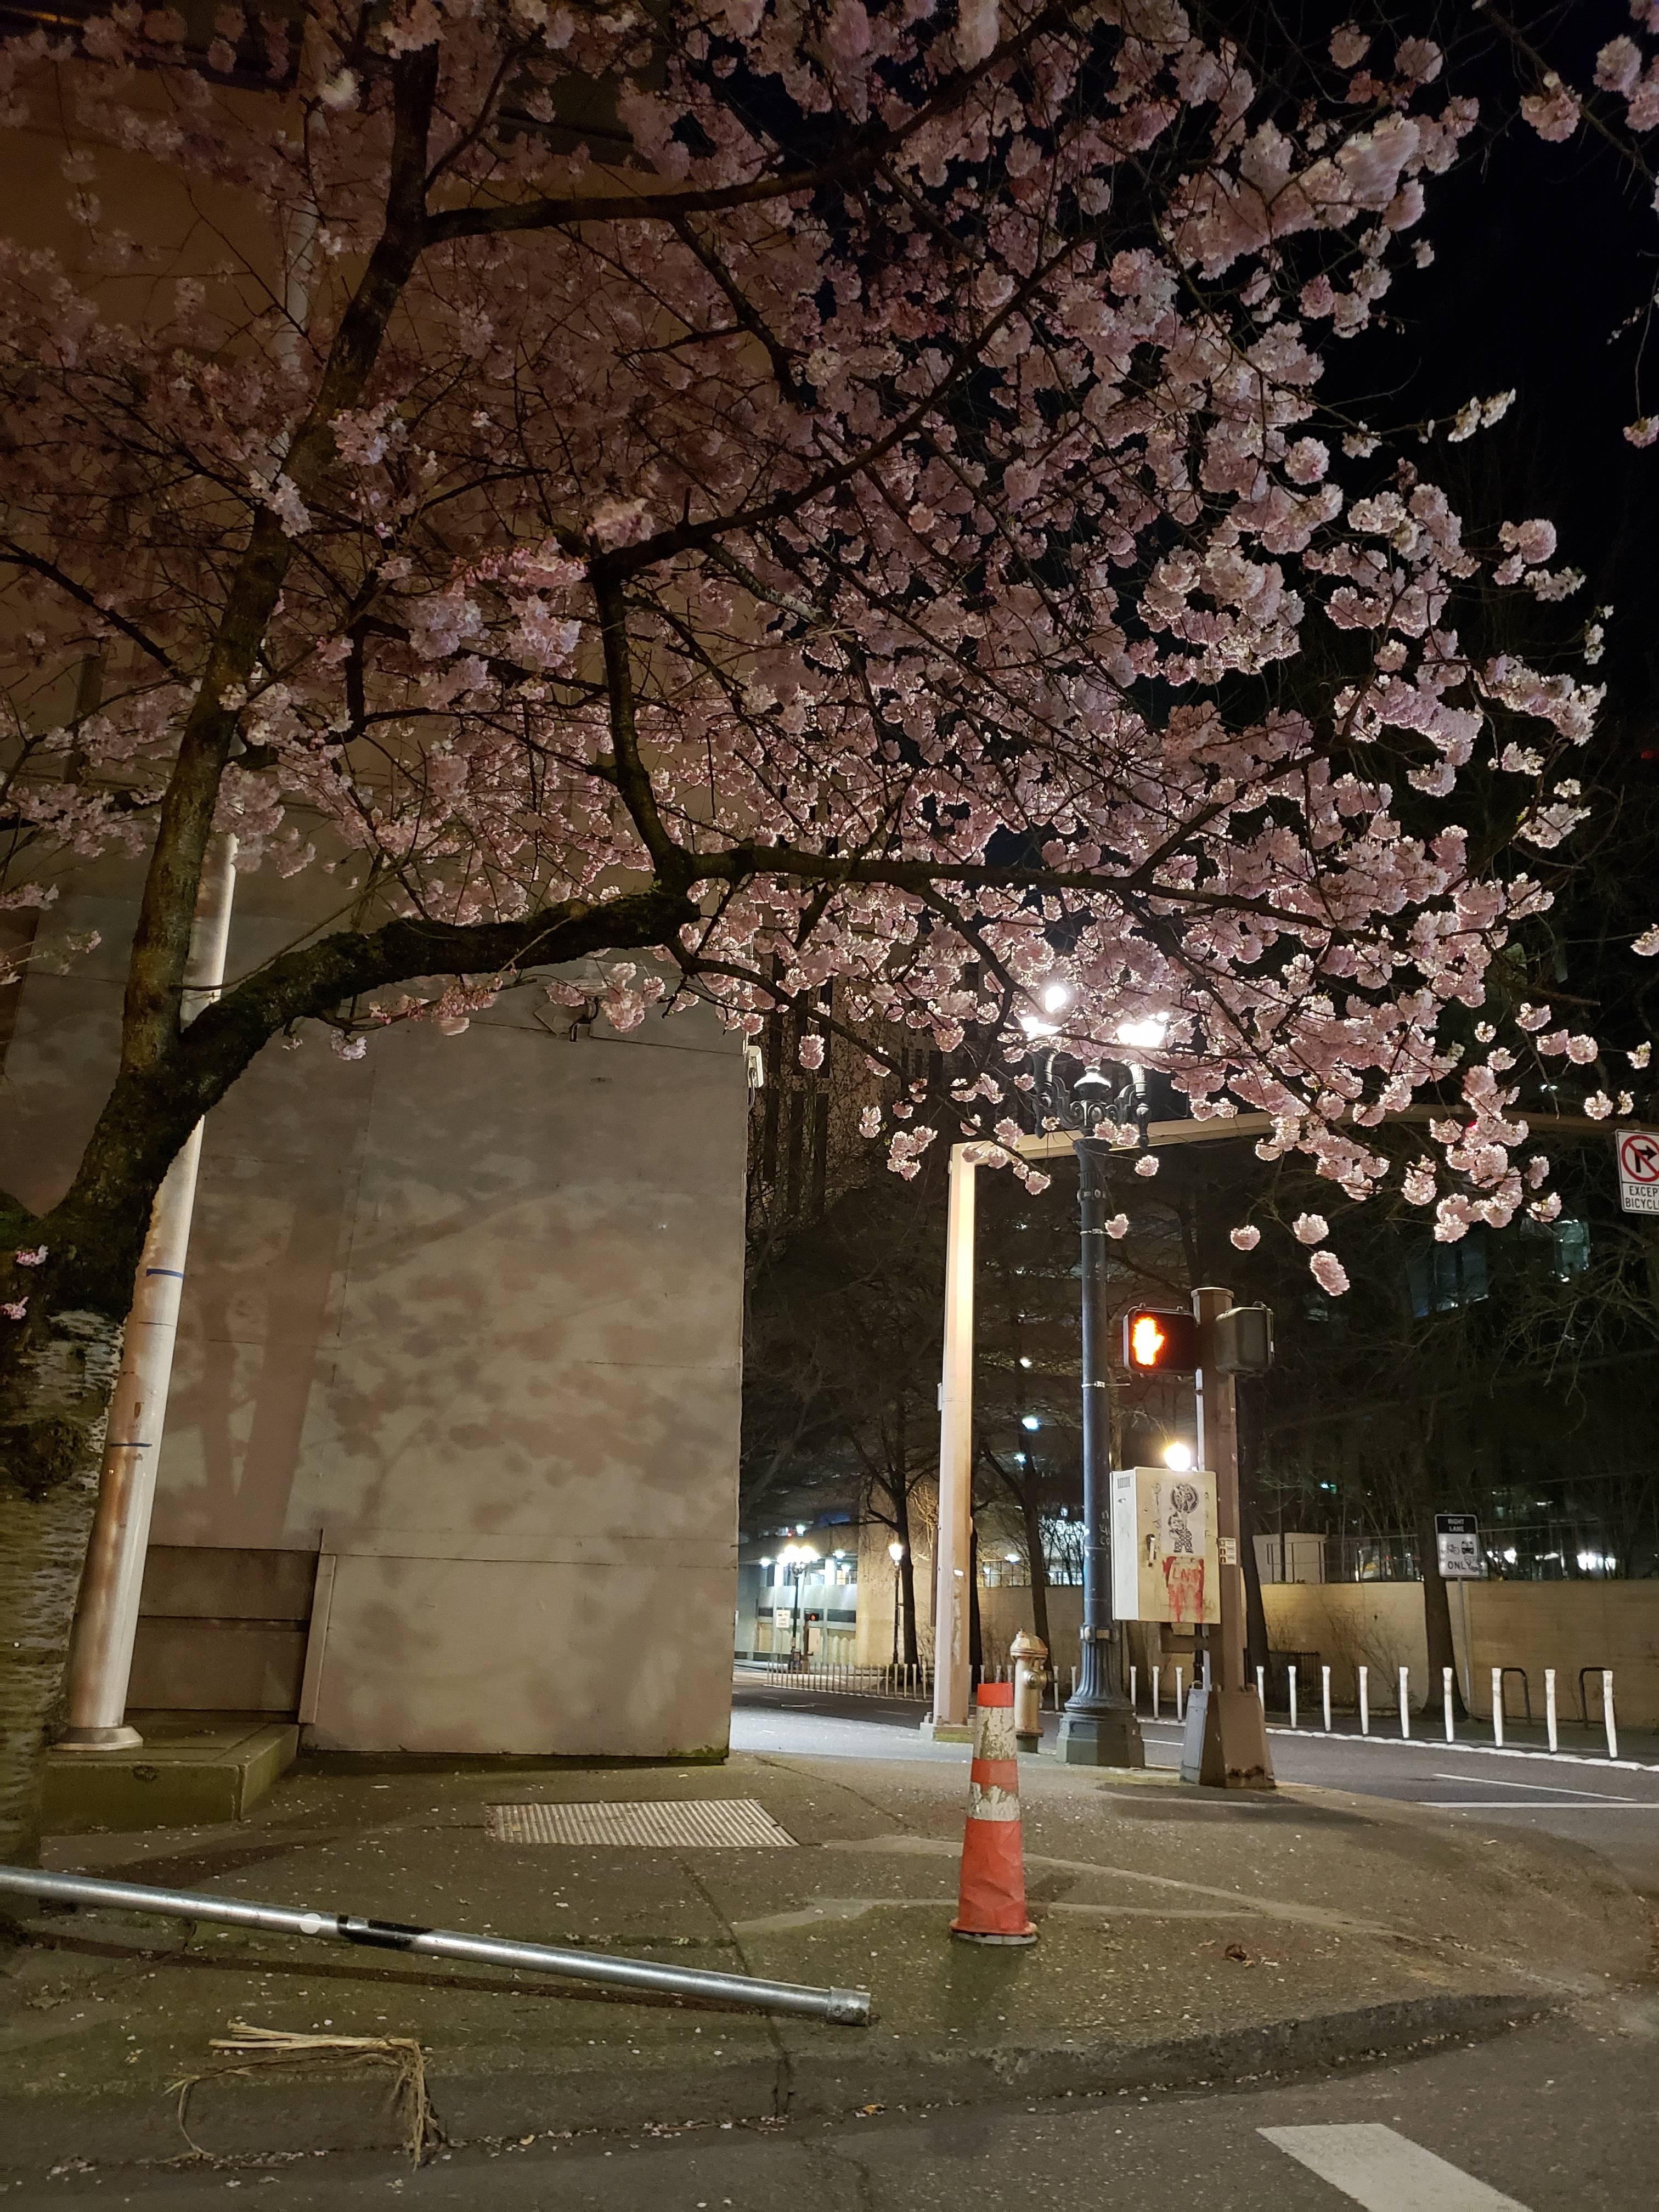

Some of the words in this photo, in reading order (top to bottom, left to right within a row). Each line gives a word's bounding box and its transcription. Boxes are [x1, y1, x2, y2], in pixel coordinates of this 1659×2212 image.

[1629, 1185, 1659, 1197] EXCEP
[1625, 1197, 1659, 1210] BICYCL
[1447, 1561, 1471, 1571] ONLY
